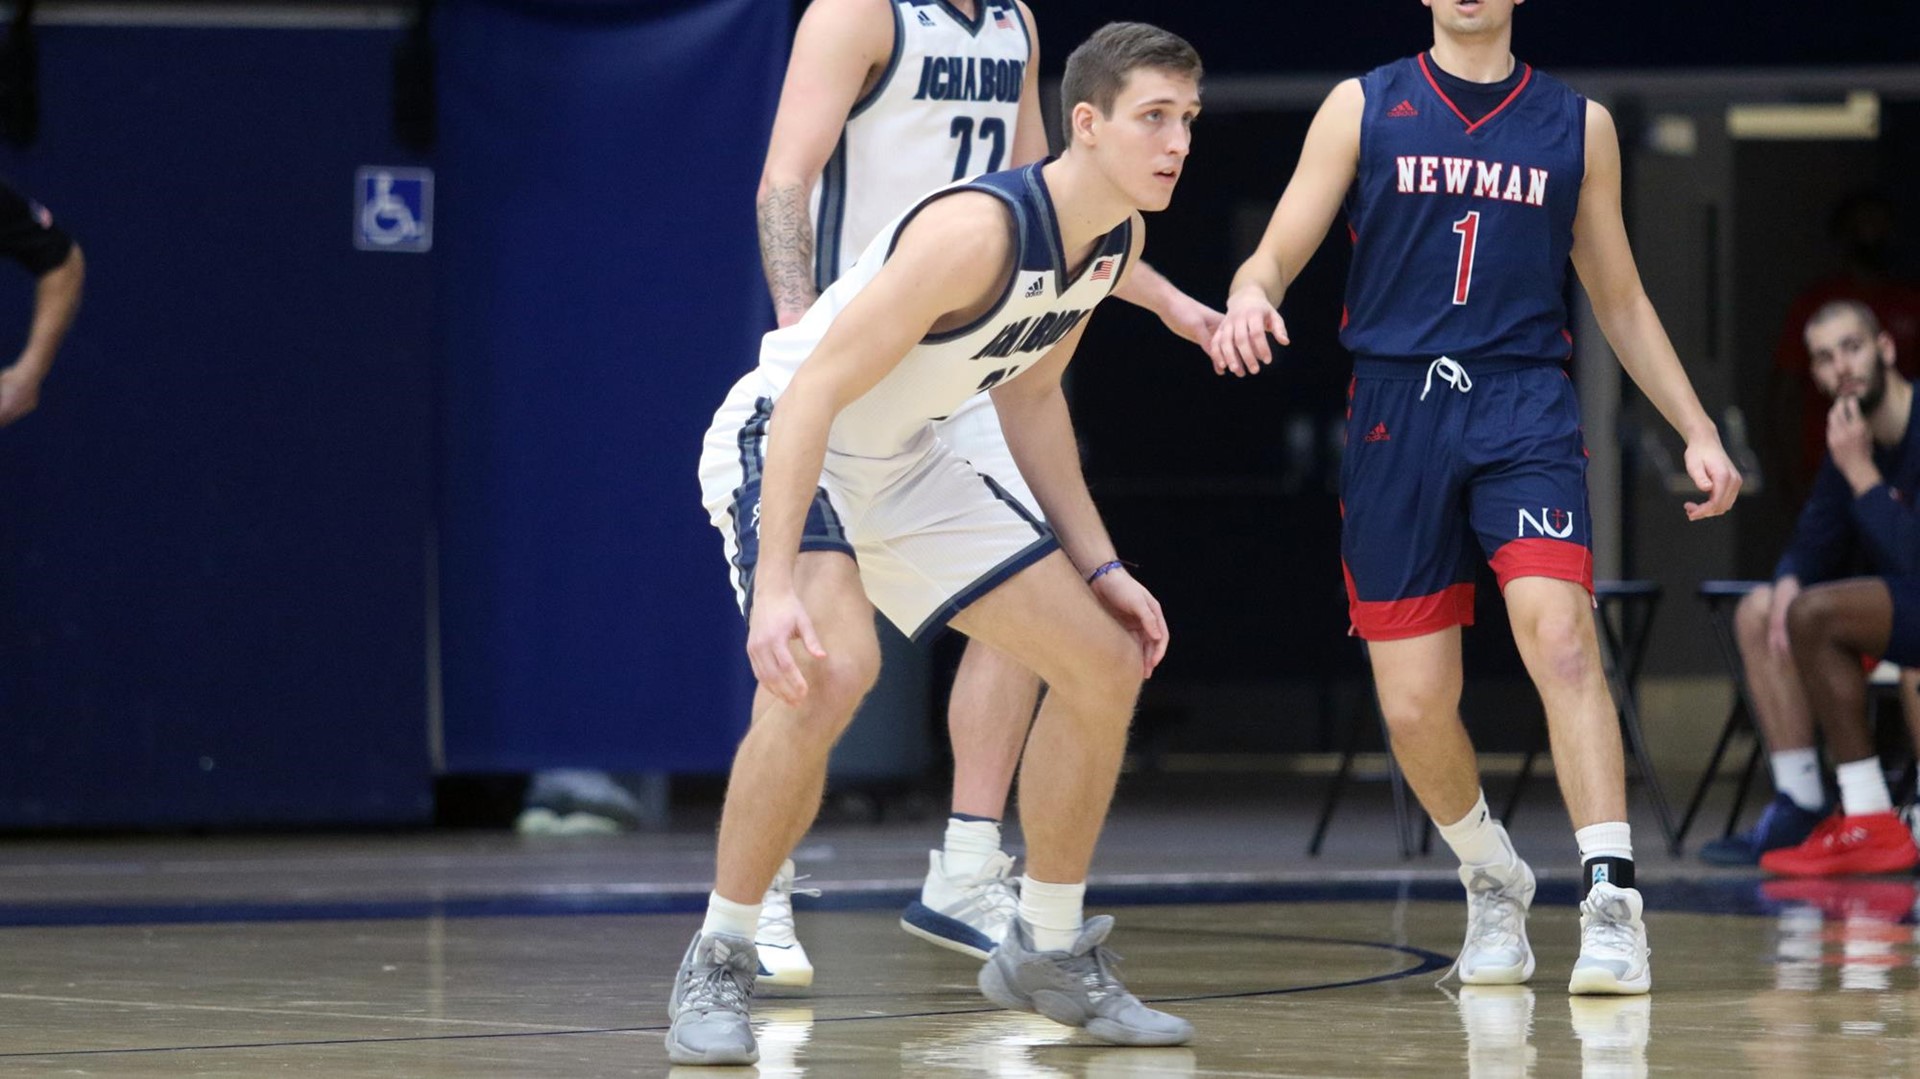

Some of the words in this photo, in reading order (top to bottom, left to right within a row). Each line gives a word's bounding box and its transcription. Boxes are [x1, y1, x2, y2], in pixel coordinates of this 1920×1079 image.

[912, 55, 1025, 103] ICHABOD
[1396, 156, 1549, 206] NEWMAN
[1452, 210, 1481, 306] 1
[1517, 507, 1573, 538] NU
